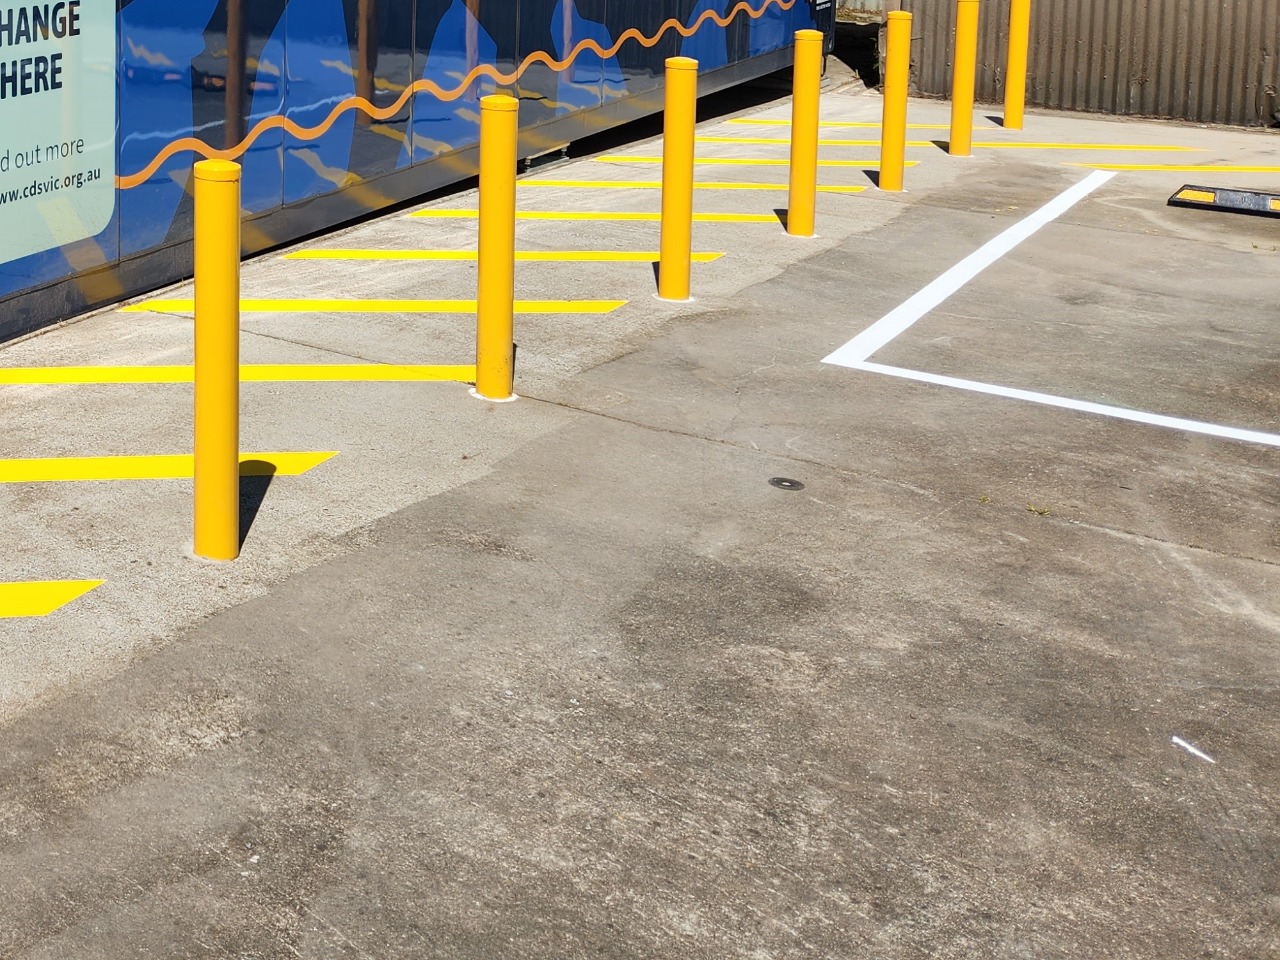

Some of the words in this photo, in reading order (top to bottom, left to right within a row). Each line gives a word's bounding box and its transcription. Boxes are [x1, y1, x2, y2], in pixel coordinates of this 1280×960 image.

[0, 52, 63, 100] HERE
[14, 144, 41, 168] out
[45, 137, 84, 163] more
